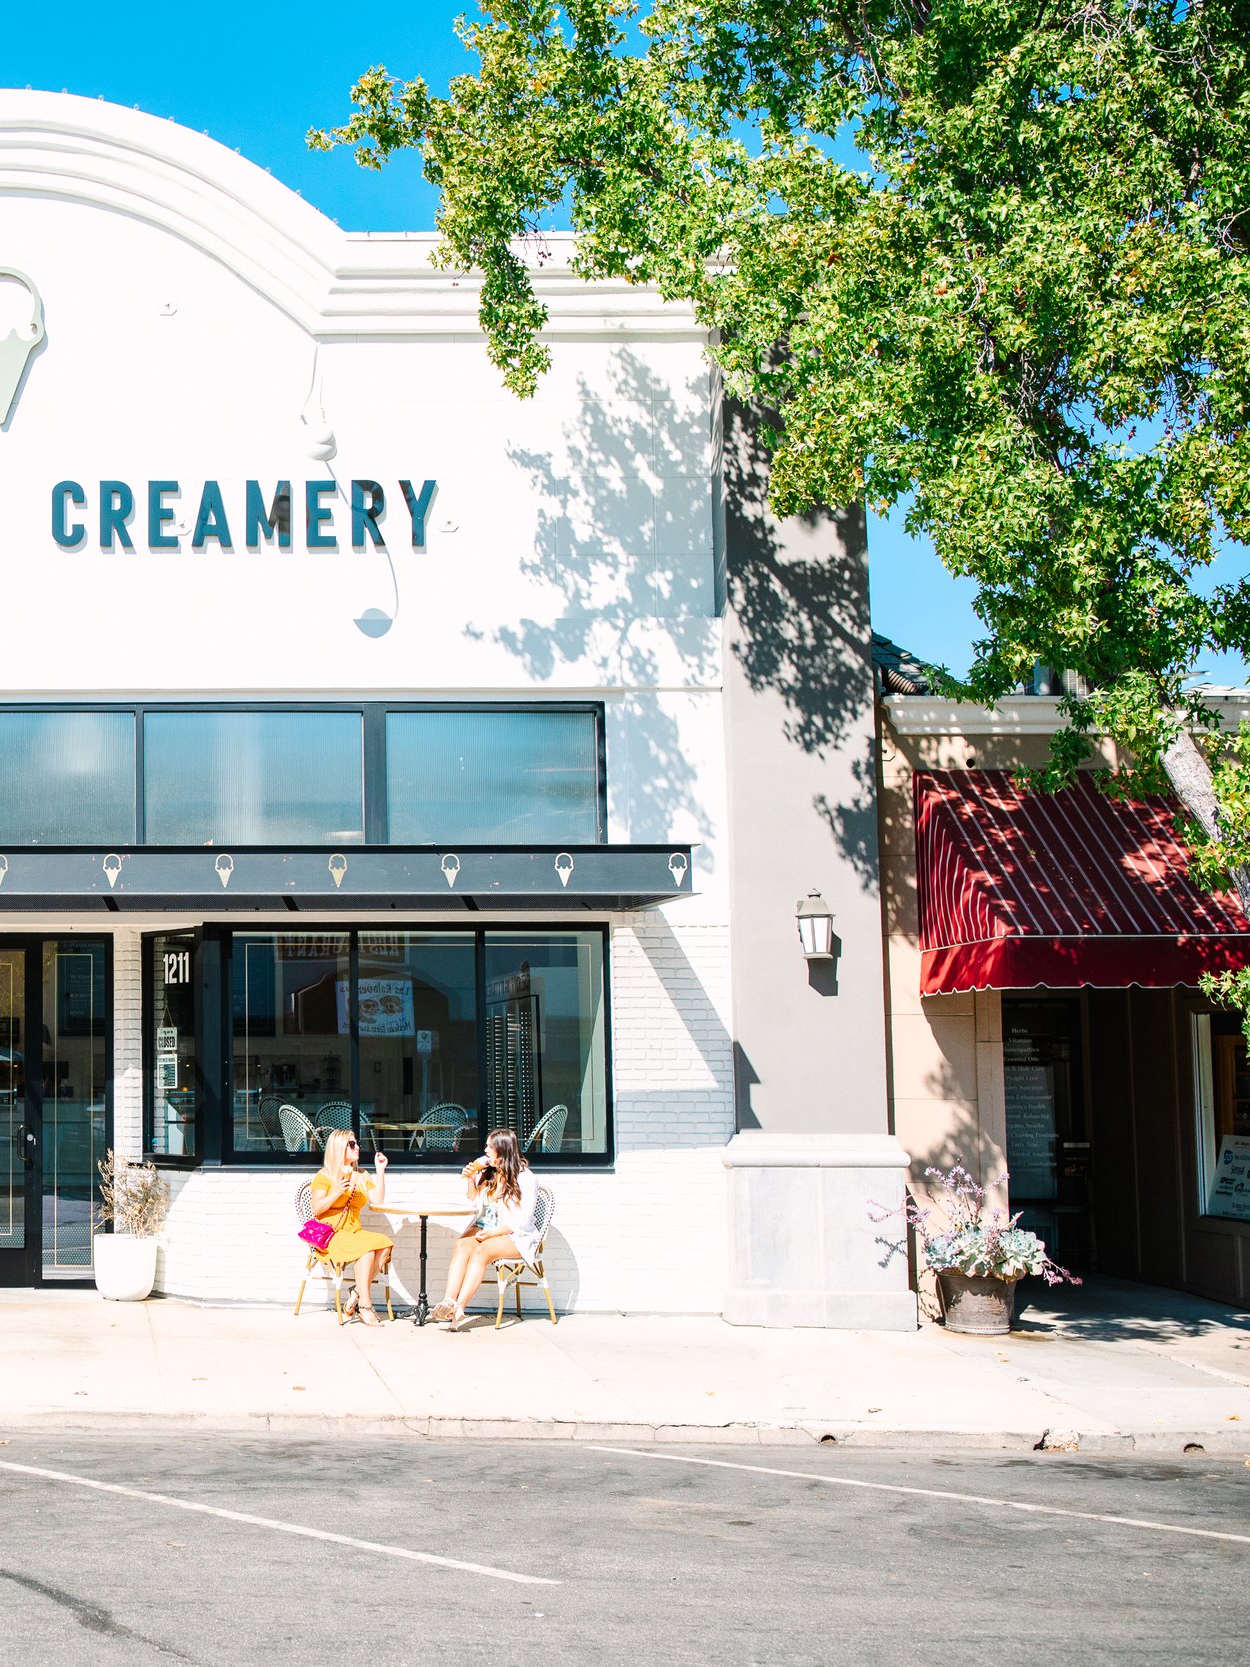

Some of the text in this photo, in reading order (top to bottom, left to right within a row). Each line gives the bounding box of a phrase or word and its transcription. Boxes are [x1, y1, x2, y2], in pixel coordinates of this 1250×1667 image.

[52, 480, 438, 548] CREAMERY
[163, 952, 190, 985] 1211
[158, 1036, 176, 1048] CLOSED
